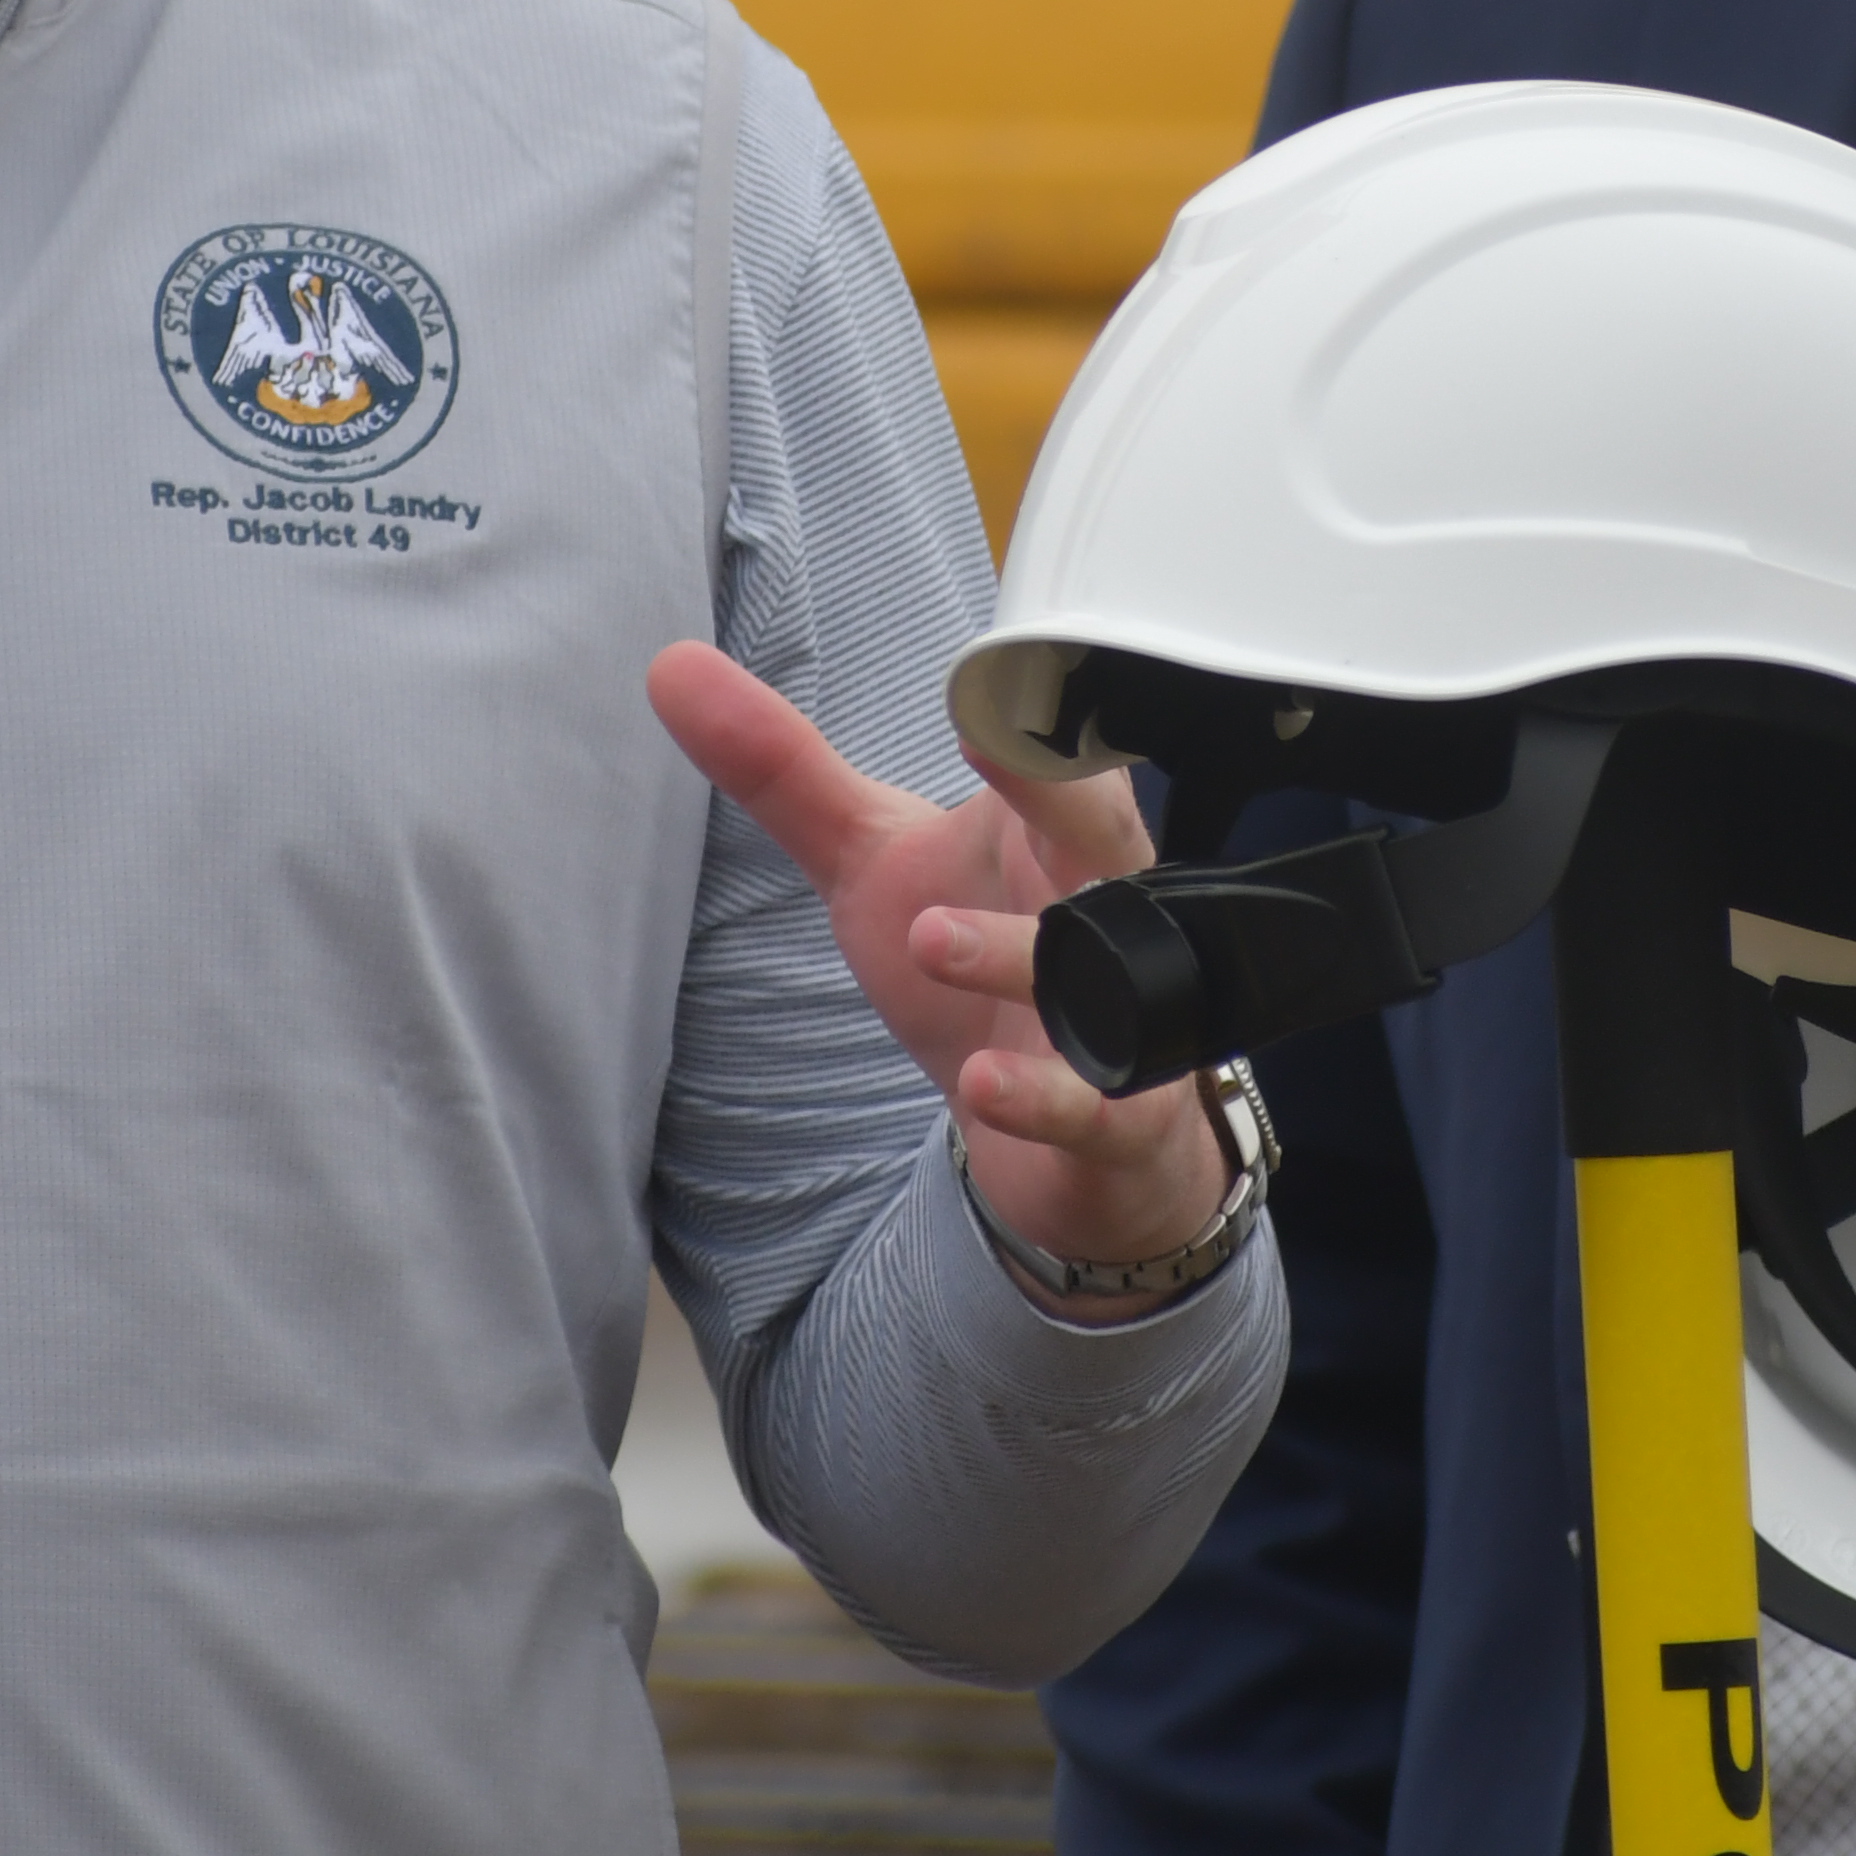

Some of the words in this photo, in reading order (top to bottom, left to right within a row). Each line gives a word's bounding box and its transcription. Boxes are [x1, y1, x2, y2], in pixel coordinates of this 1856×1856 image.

[163, 250, 217, 336] STATE
[287, 228, 445, 340] LOUISIANA
[204, 255, 272, 307] UNION
[292, 254, 393, 305] JUSTICE
[236, 400, 395, 447] CONFIDENCE
[150, 481, 230, 514] Rep.
[242, 484, 354, 513] Jacob
[364, 488, 482, 531] Landry
[227, 518, 358, 548] District
[367, 524, 412, 552] 49
[1660, 1638, 1765, 1856] P
